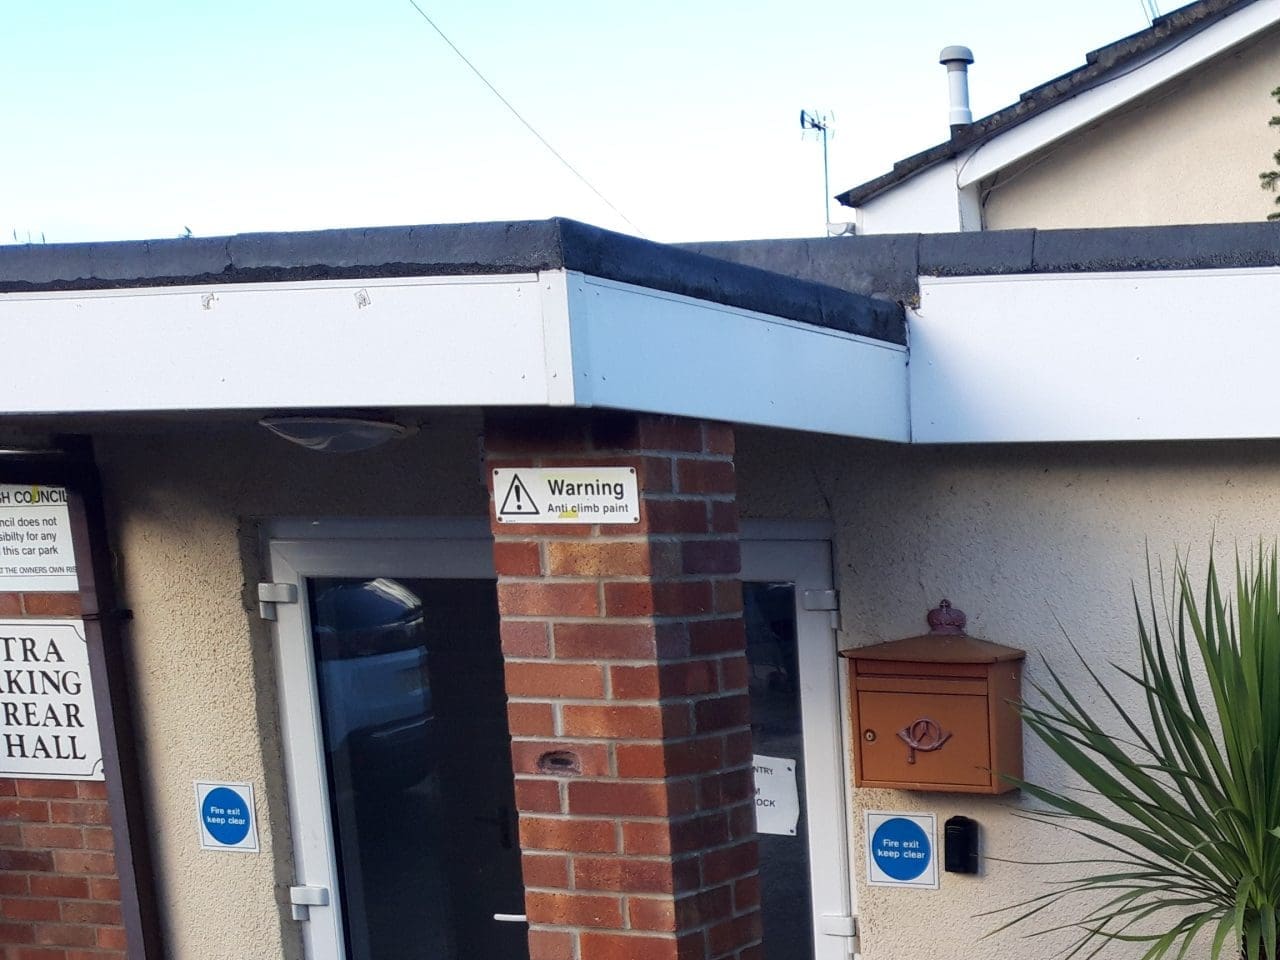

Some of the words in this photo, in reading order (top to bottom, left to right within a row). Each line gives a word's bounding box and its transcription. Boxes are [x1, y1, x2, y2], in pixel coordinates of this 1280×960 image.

[547, 479, 624, 500] Warning
[547, 503, 568, 513] Anti
[571, 503, 600, 513] climb
[603, 503, 629, 515] paint
[18, 517, 40, 527] does
[43, 517, 58, 526] not
[27, 531, 38, 541] for
[41, 533, 57, 542] any
[3, 545, 20, 556] this
[22, 548, 35, 556] car
[38, 545, 59, 557] park
[0, 670, 82, 695] KING
[1, 702, 85, 728] REAR
[3, 734, 86, 760] HALL
[210, 806, 225, 814] Fire
[227, 808, 241, 816] exit
[206, 816, 226, 825] keep
[228, 816, 246, 825] clear
[883, 838, 900, 848] Fire
[903, 840, 920, 848] exit
[878, 848, 900, 859] keep
[903, 850, 926, 859] clear
